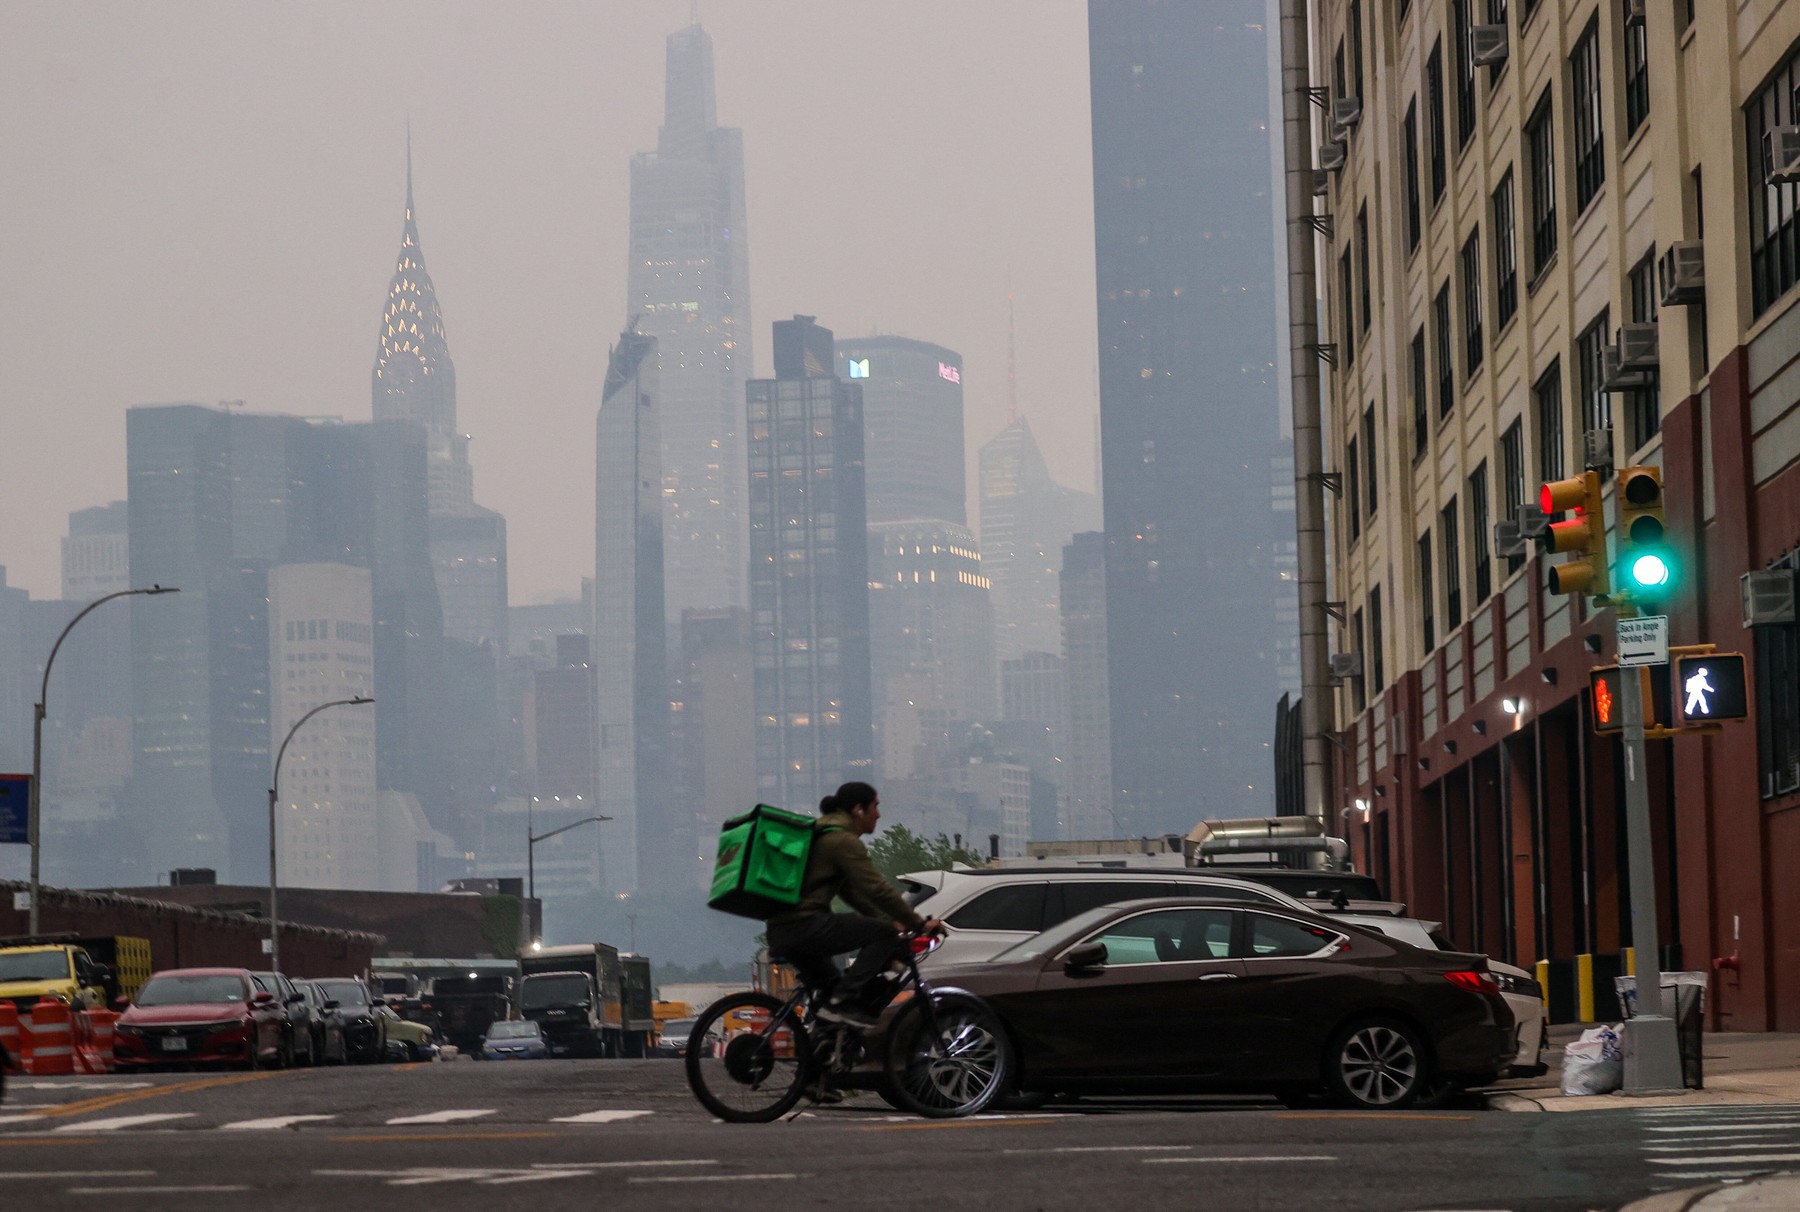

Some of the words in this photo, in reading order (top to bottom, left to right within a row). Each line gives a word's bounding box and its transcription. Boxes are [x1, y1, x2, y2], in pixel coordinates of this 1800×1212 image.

[938, 361, 960, 384] MetLife
[1620, 623, 1634, 633] Back
[1620, 634, 1643, 643] Parking
[1643, 633, 1656, 642] Only
